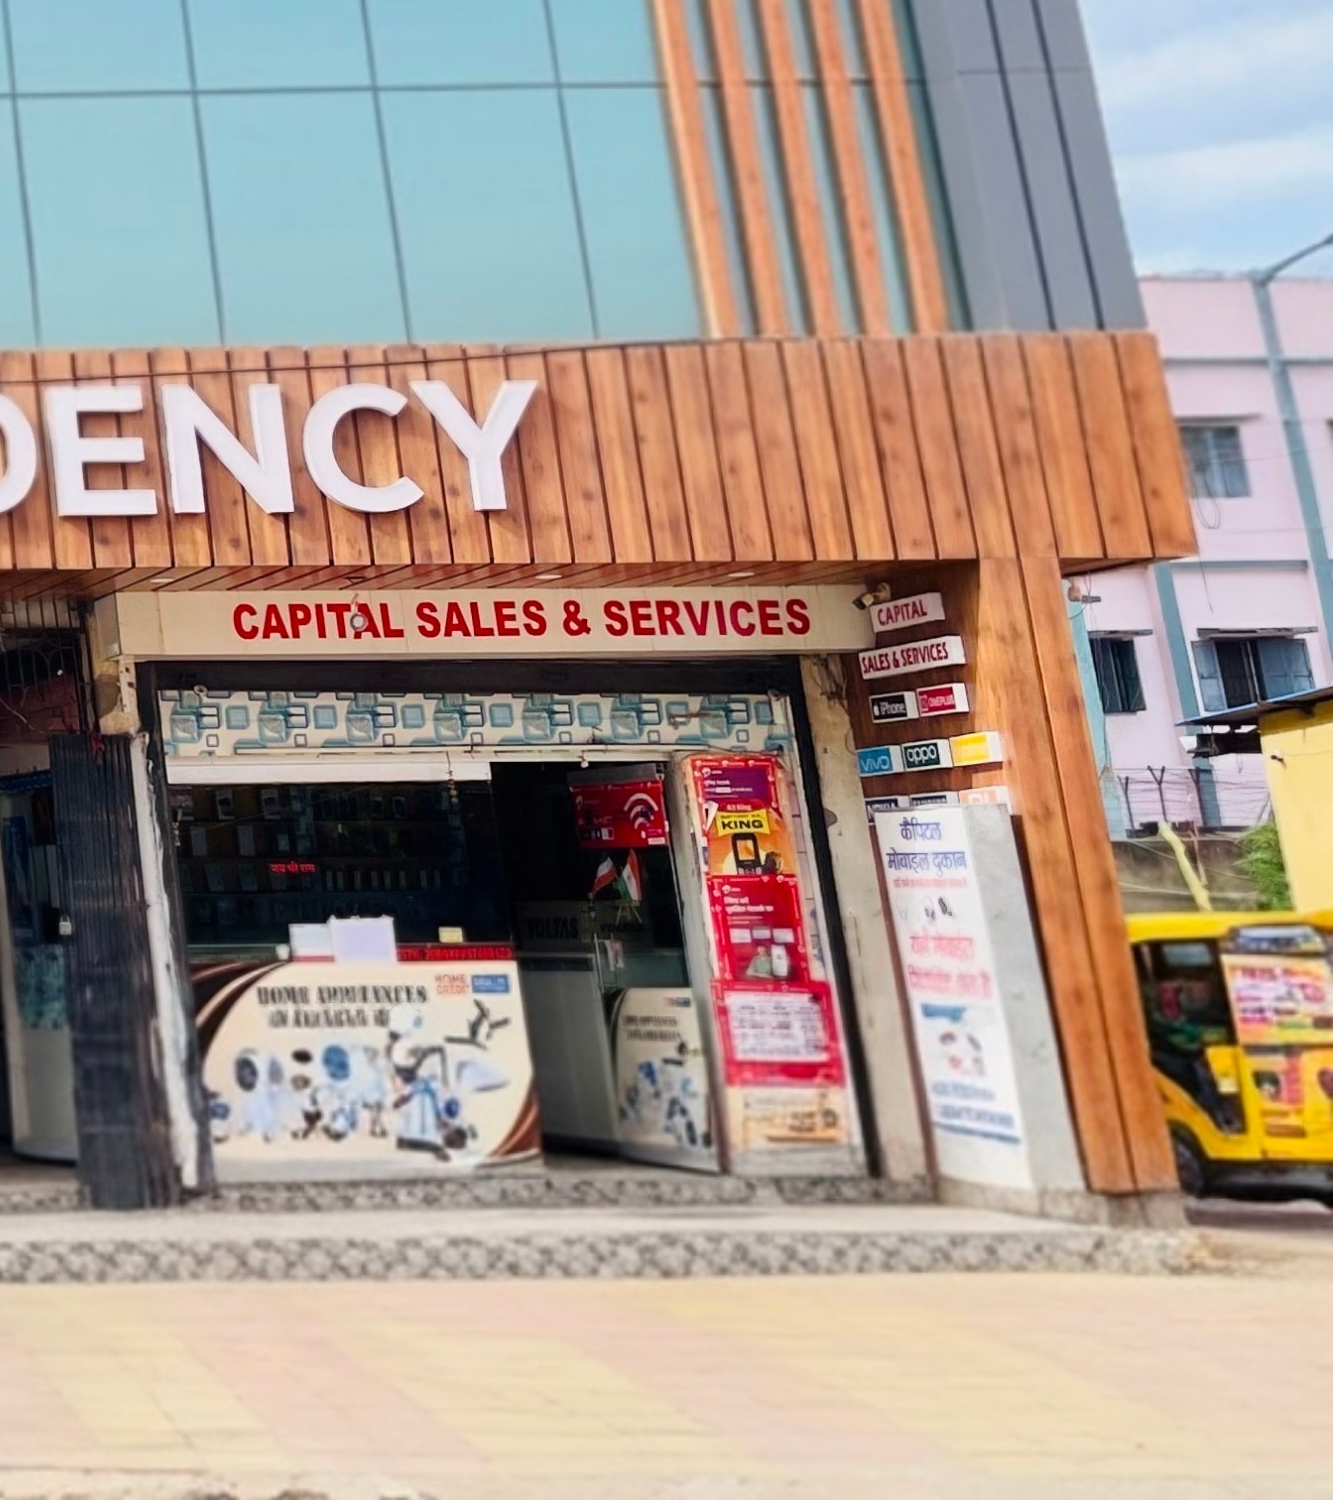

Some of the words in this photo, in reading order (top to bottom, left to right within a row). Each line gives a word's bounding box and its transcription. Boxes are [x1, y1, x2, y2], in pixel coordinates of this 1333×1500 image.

[233, 602, 404, 639] CAPITAL
[416, 600, 547, 638] SALES
[562, 600, 591, 636] &
[603, 598, 811, 636] SERVICES
[877, 599, 928, 627] CAPITAL
[862, 653, 891, 674] SALES
[900, 641, 949, 667] SERVICES
[721, 819, 764, 830] KING
